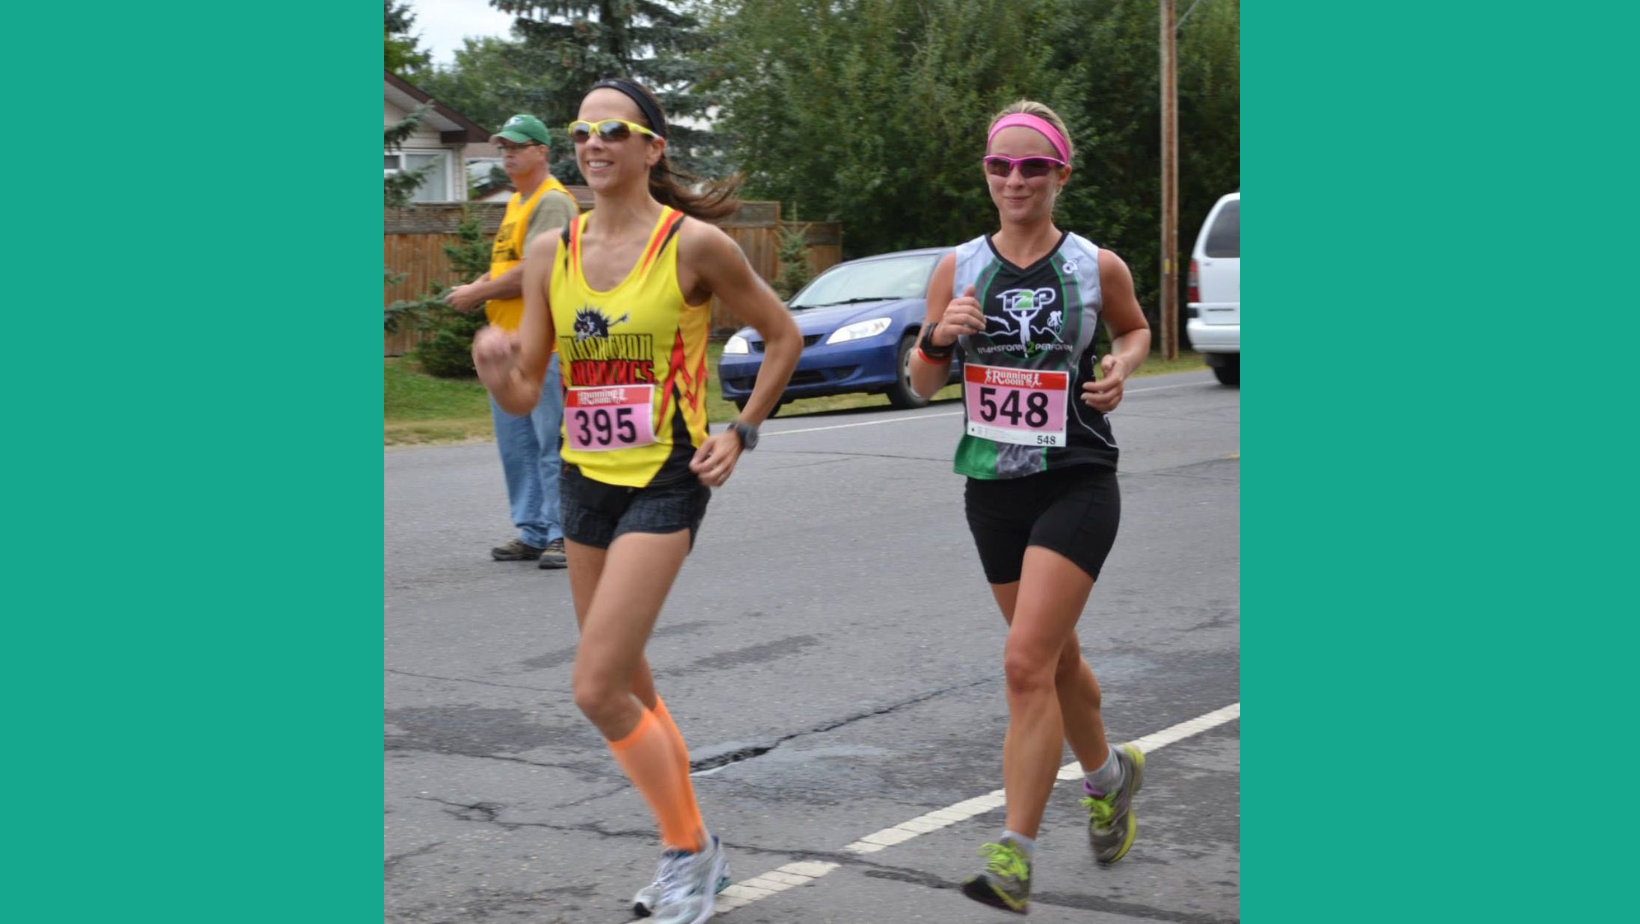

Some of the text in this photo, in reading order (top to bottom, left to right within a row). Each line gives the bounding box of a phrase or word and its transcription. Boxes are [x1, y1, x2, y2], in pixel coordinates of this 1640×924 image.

[1027, 341, 1035, 354] 2
[992, 370, 1032, 384] Running
[980, 387, 1049, 428] 548
[575, 408, 637, 446] 395
[1036, 435, 1057, 445] 548
